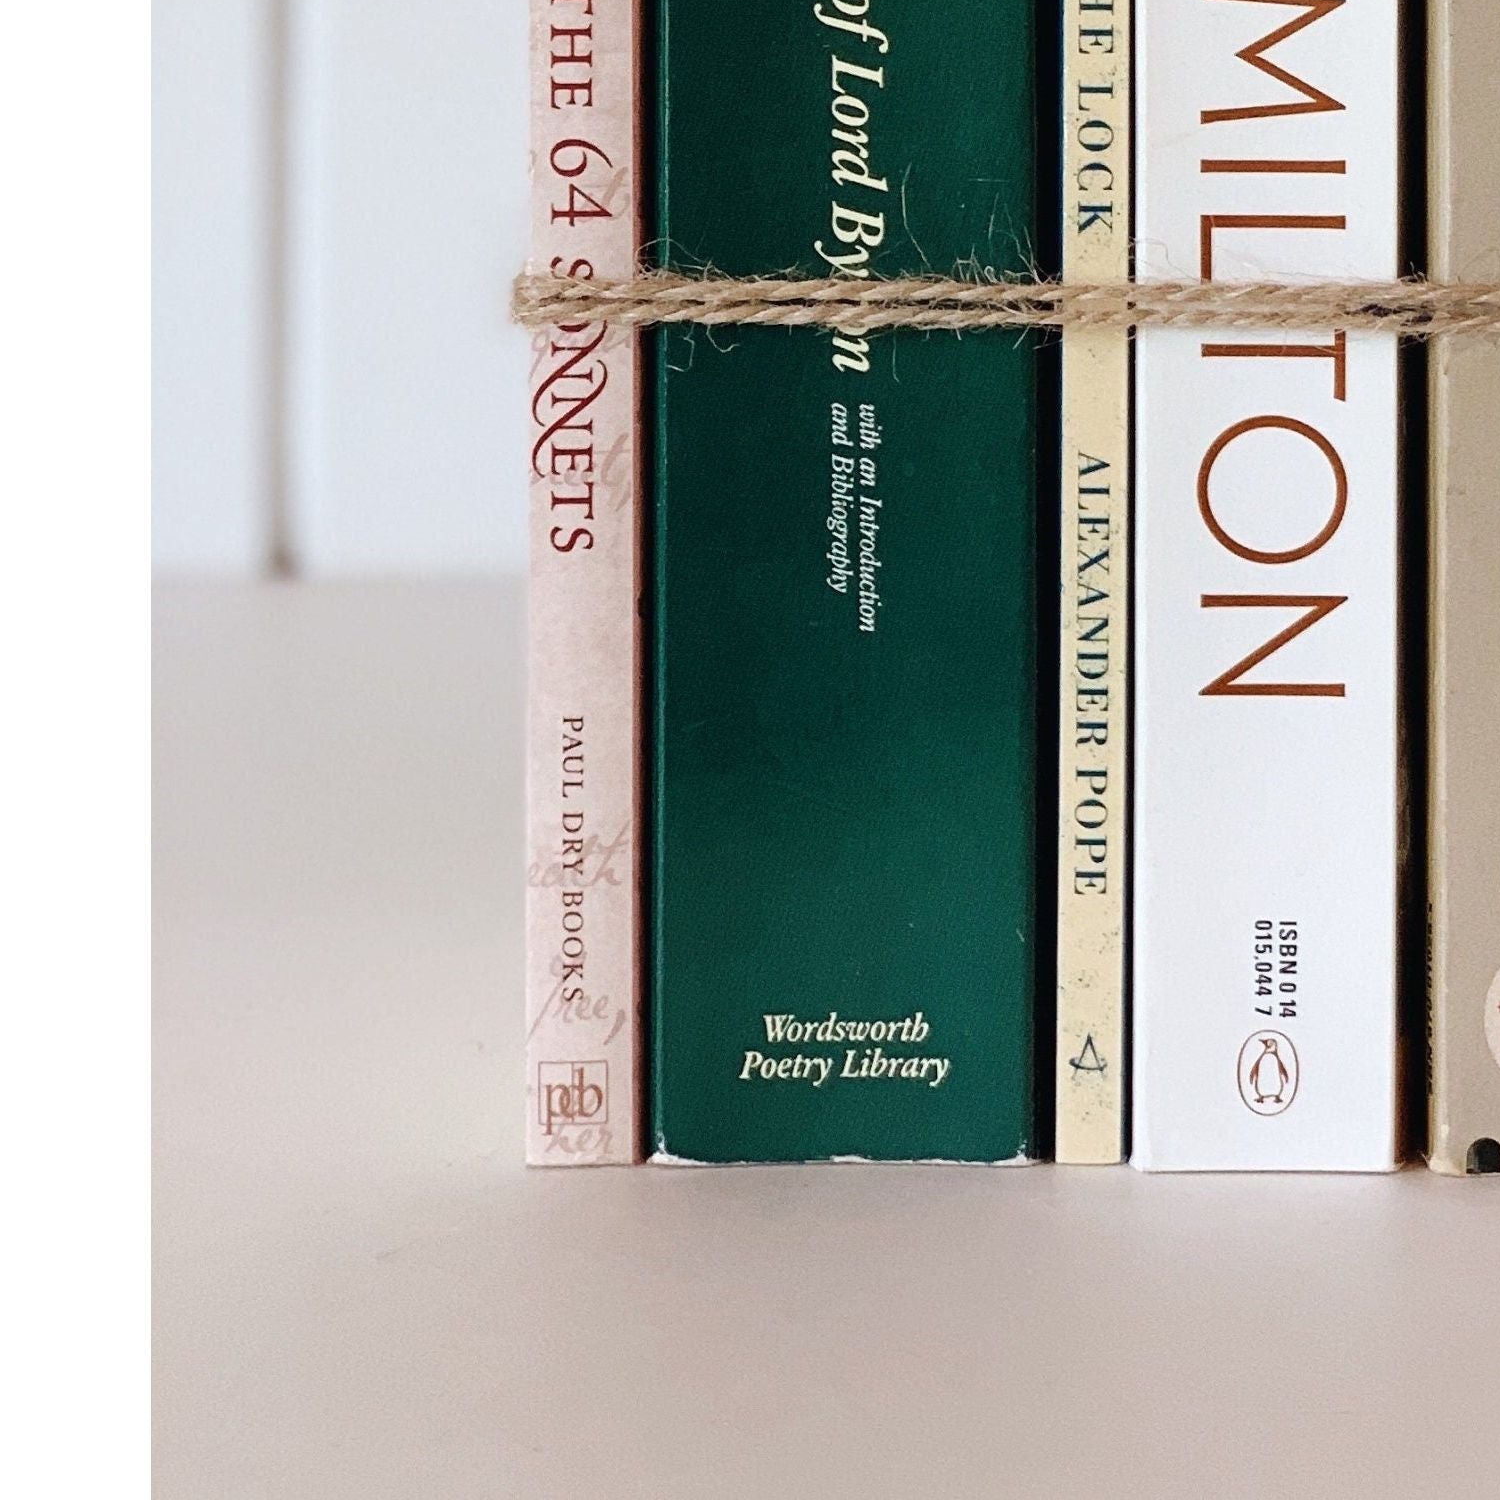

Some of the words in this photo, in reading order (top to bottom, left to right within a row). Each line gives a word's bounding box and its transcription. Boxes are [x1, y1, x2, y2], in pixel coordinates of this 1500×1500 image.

[830, 56, 889, 192] Lord
[1076, 82, 1115, 235] LOCK
[549, 138, 613, 228] 64
[814, 201, 887, 373] Byn
[531, 256, 607, 553] SNNETS
[832, 403, 854, 447] and
[858, 403, 883, 448] with
[858, 457, 876, 484] an
[825, 453, 854, 592] Bibliography
[858, 495, 883, 631] Introduction
[1075, 450, 1111, 749] ALEXANDER
[562, 715, 584, 798] PAUL
[562, 811, 584, 875] DRY
[1073, 766, 1109, 897] POPE
[562, 891, 584, 1003] BOOKS
[1278, 920, 1299, 974] ISBN
[738, 1052, 834, 1086] Poetry
[839, 1052, 951, 1086] Library
[762, 1012, 930, 1043] Wordsworth
